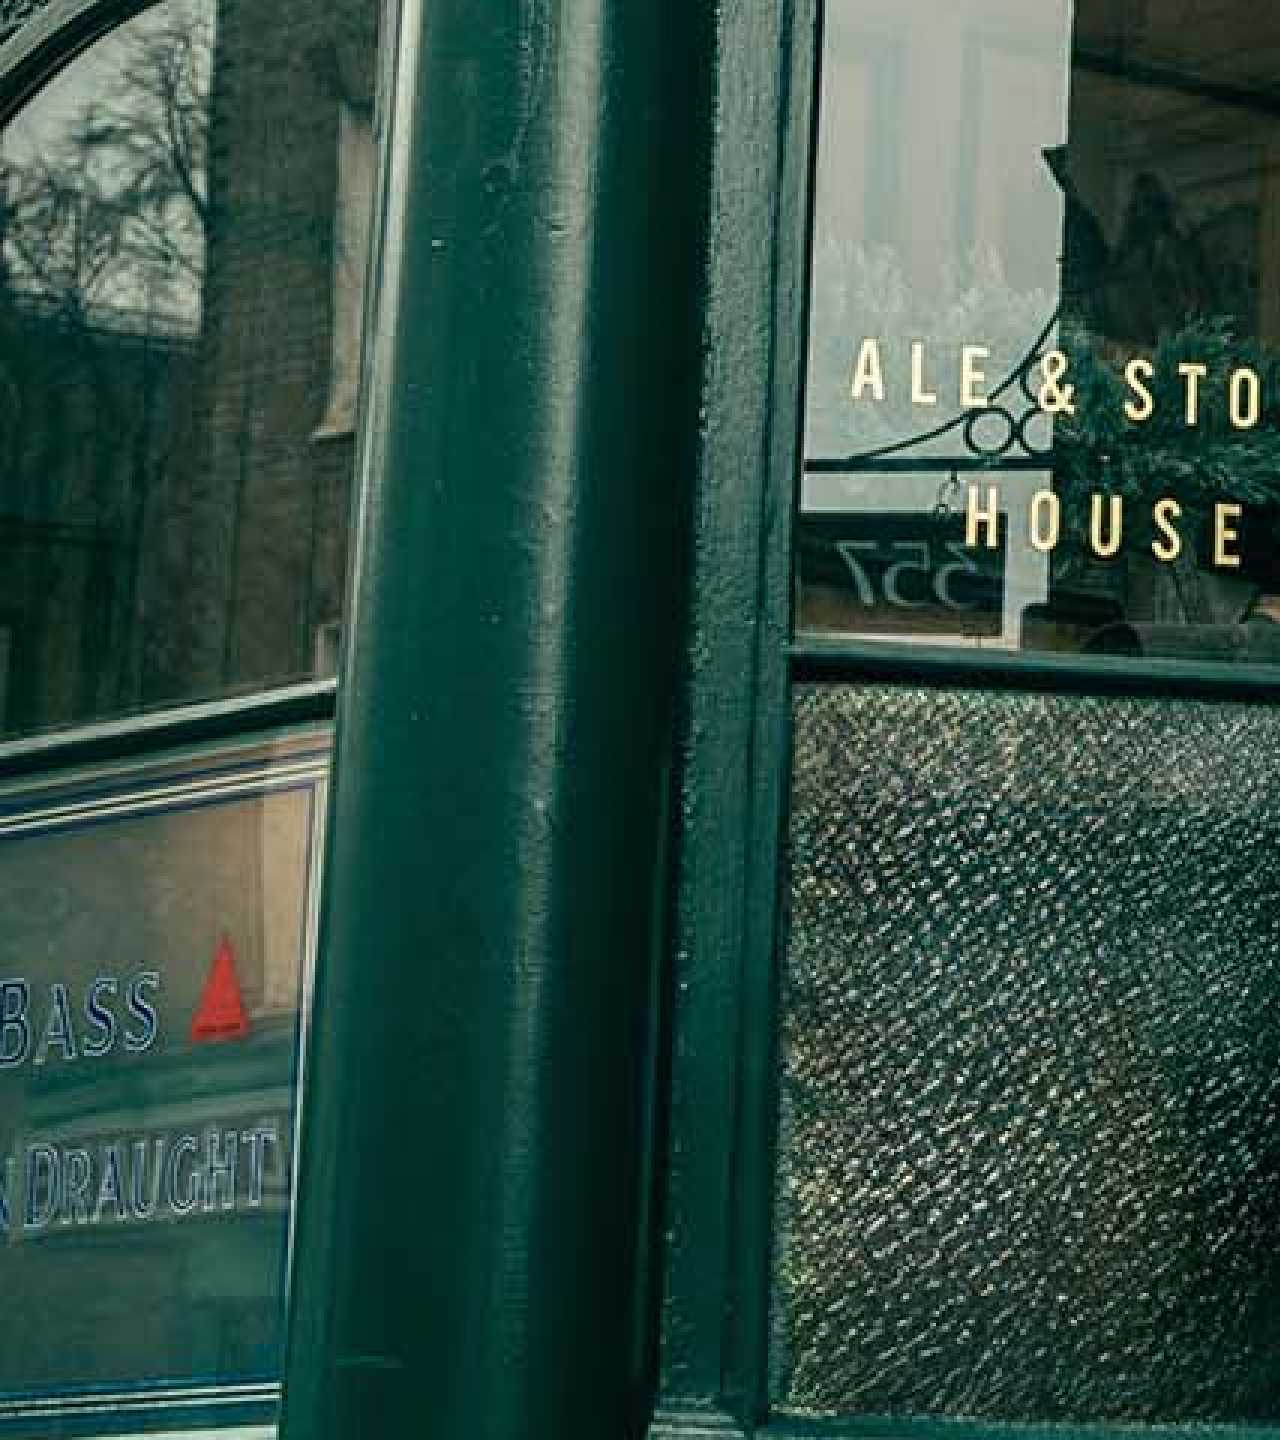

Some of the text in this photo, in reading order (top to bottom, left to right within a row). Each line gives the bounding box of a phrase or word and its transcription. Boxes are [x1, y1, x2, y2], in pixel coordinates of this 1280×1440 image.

[850, 338, 993, 407] ALE
[1037, 350, 1077, 416] &
[964, 485, 1243, 567] HOUSE
[0, 970, 161, 1068] BASS
[24, 1125, 277, 1232] DRAUGHT
